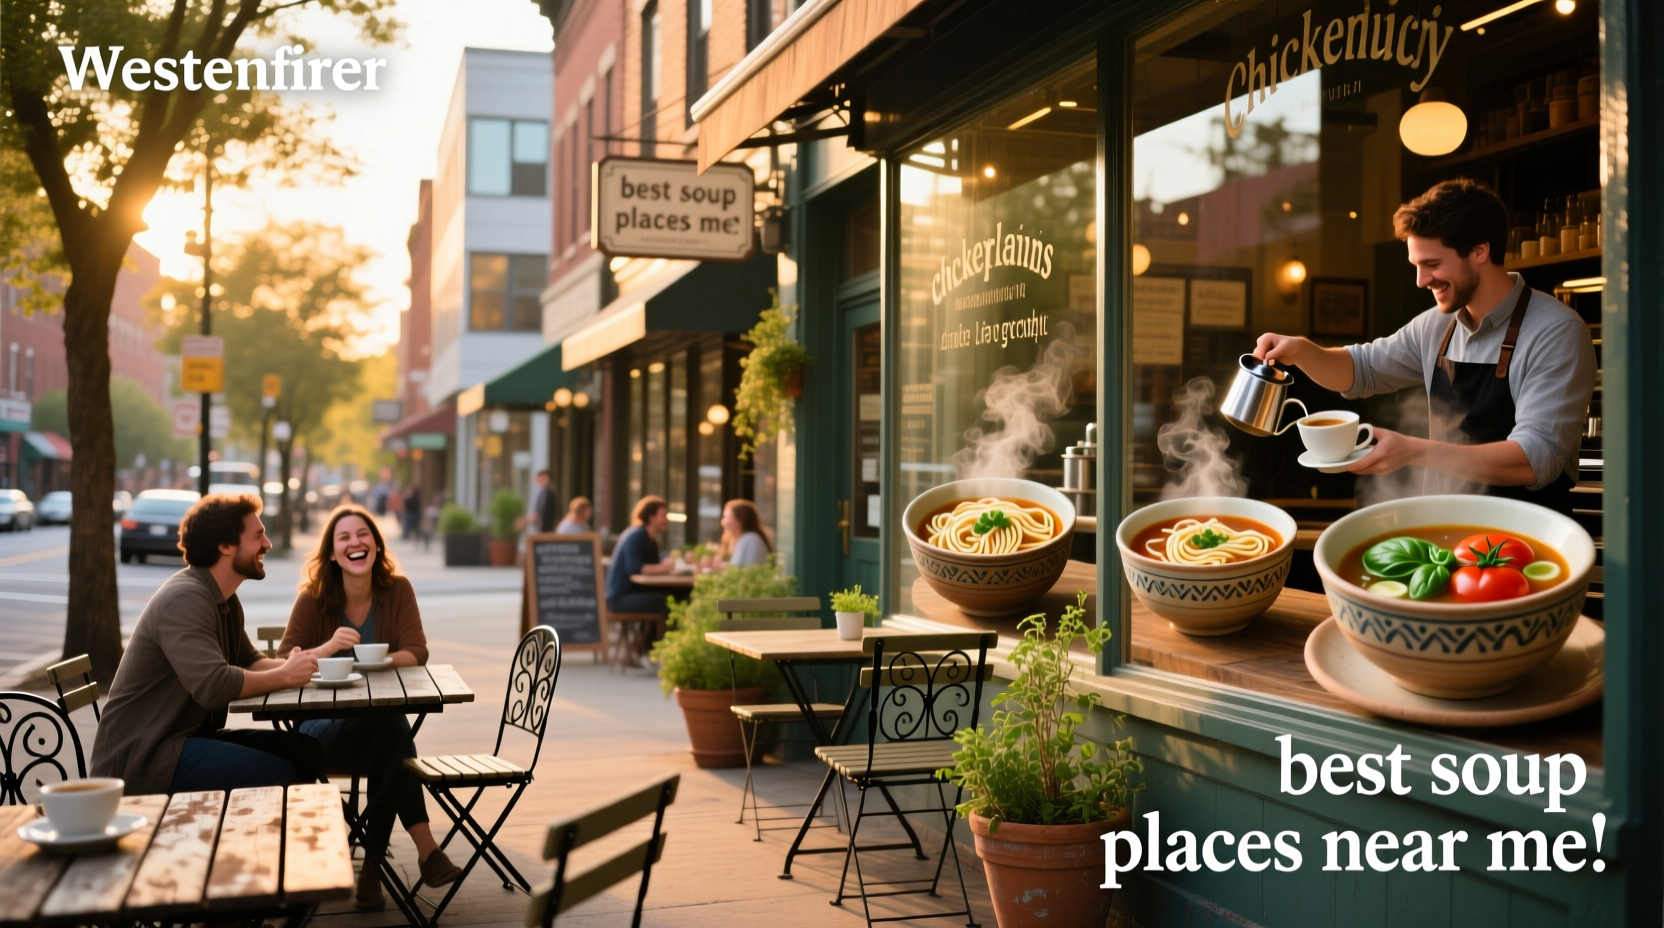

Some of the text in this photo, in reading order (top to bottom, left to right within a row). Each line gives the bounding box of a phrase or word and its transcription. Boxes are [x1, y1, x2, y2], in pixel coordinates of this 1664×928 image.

[621, 174, 737, 211] best soup
[615, 206, 692, 235] places
